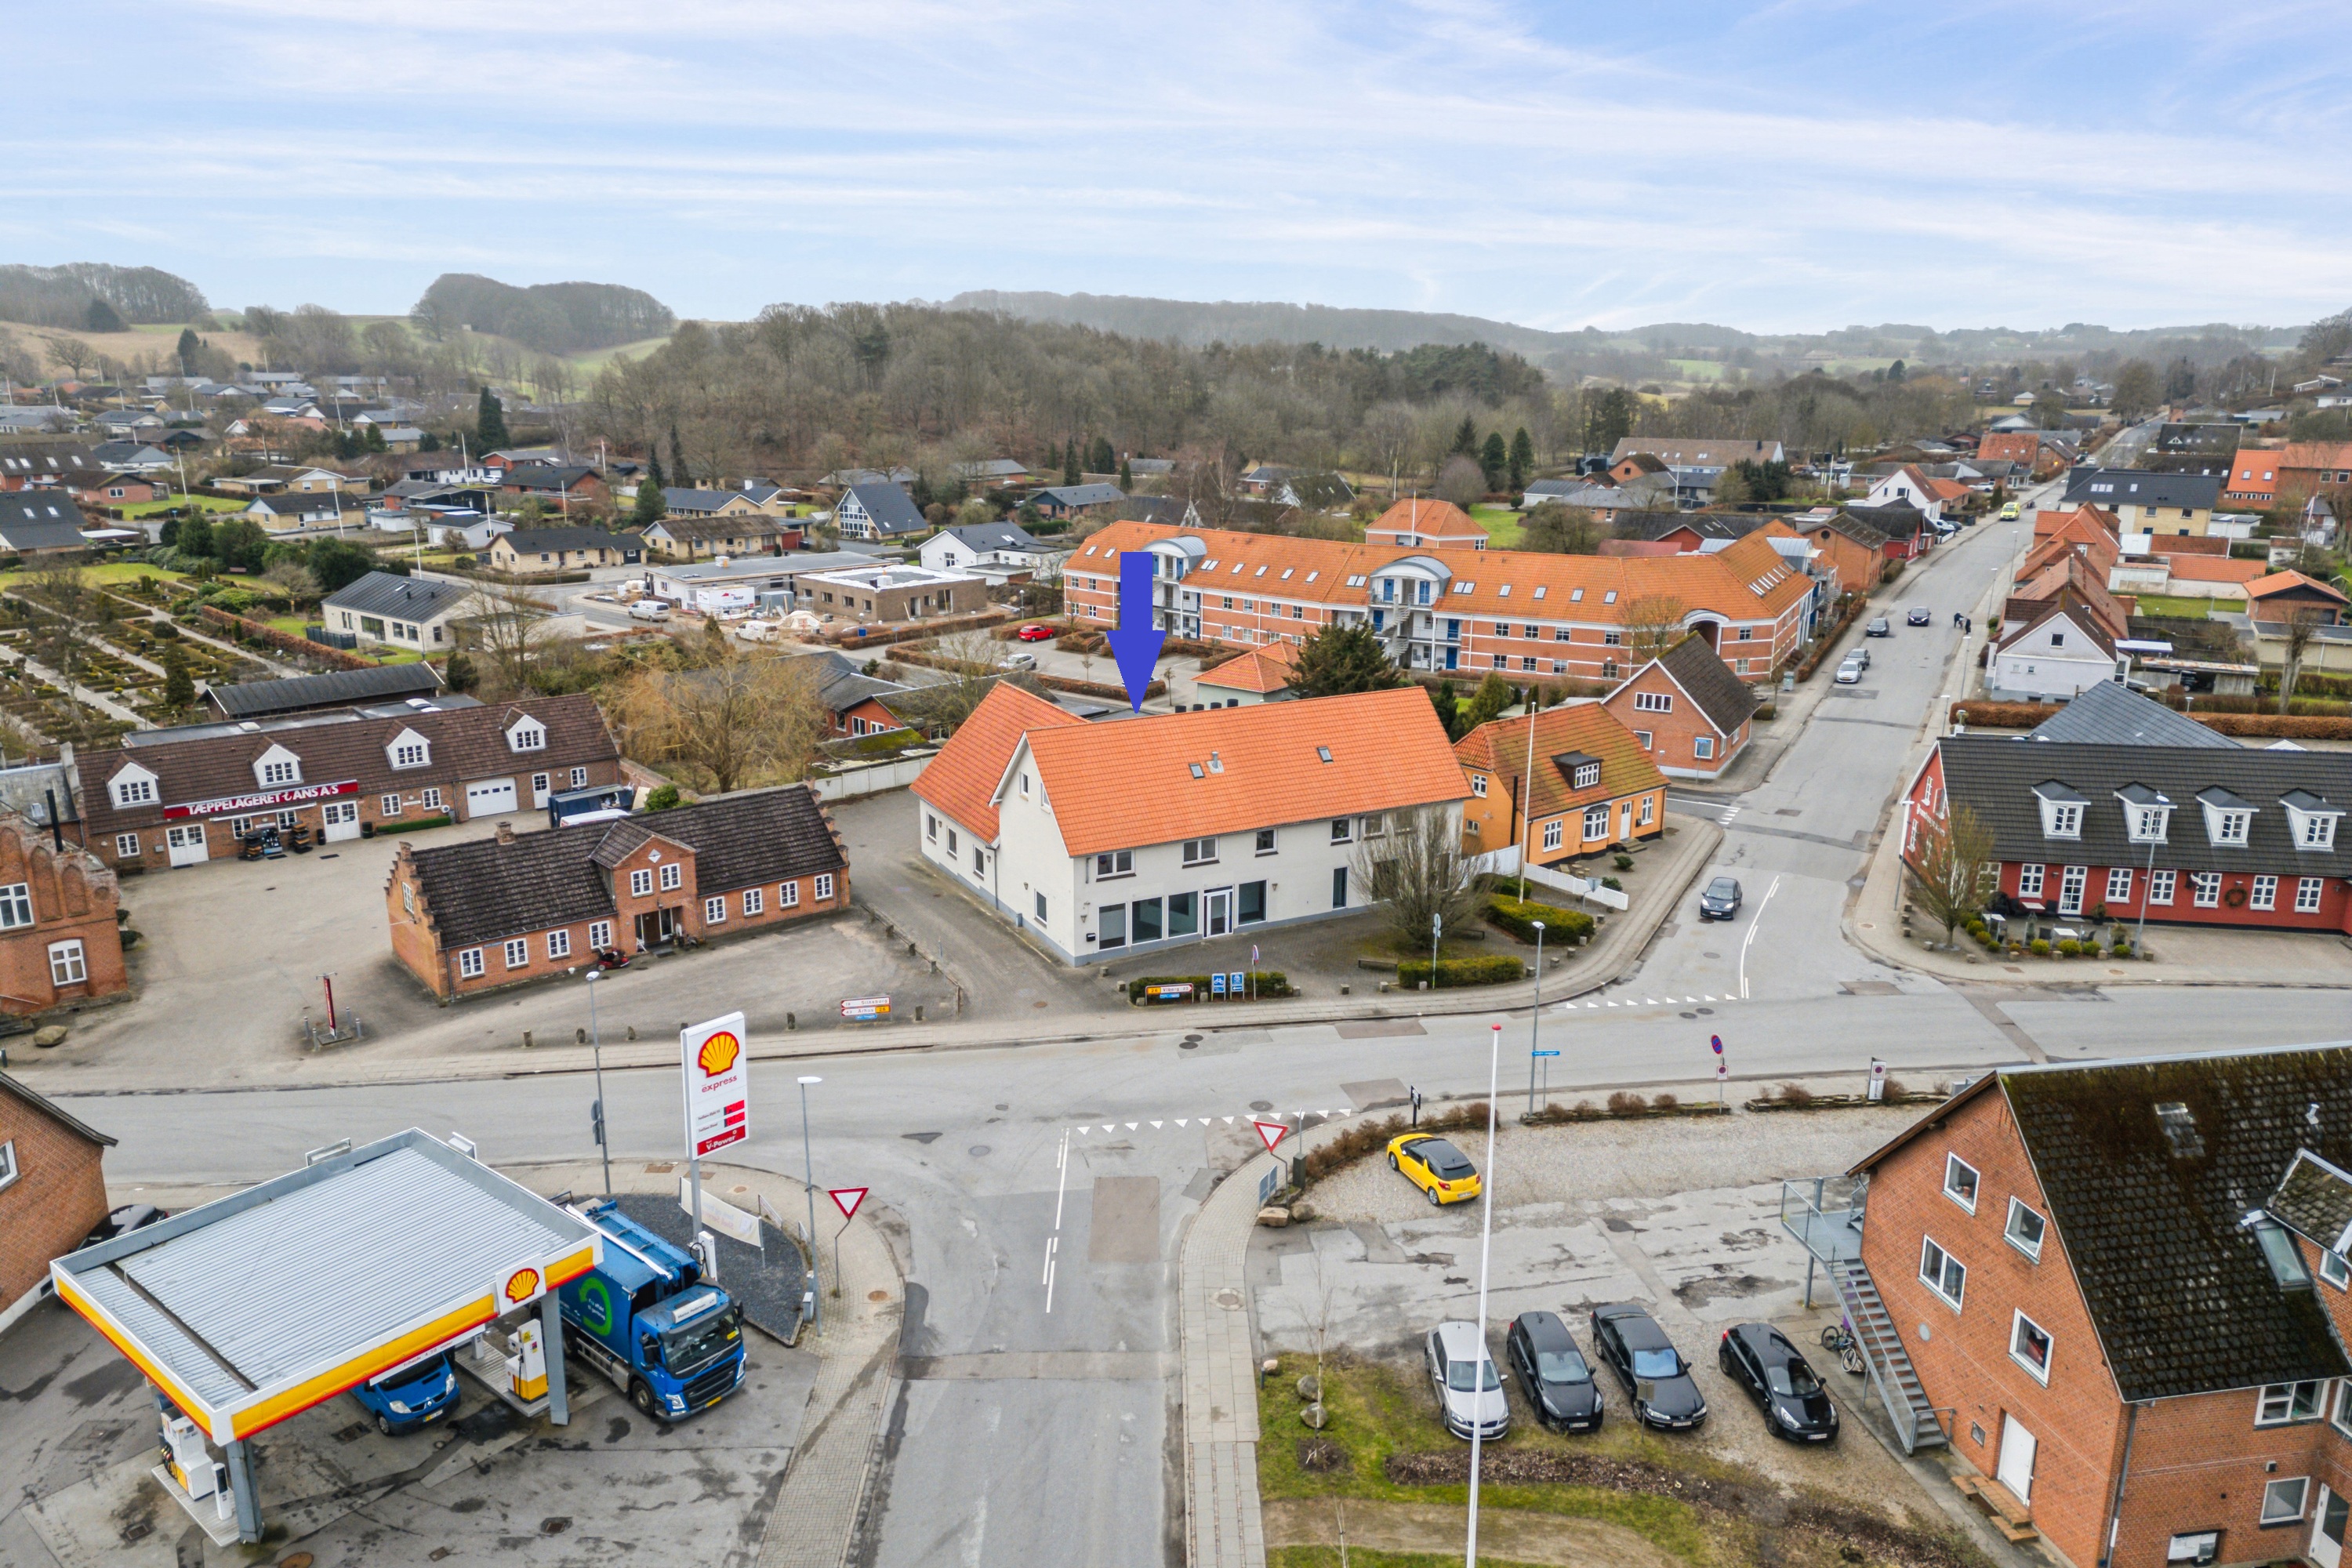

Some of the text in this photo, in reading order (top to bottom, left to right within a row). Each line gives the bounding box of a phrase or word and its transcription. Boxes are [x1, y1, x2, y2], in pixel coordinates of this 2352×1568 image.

[186, 792, 281, 815] TÆPPELAGERET
[292, 786, 318, 800] ANS
[320, 785, 339, 797] A/S
[701, 1074, 738, 1093] express
[706, 1135, 736, 1150] V-Power
